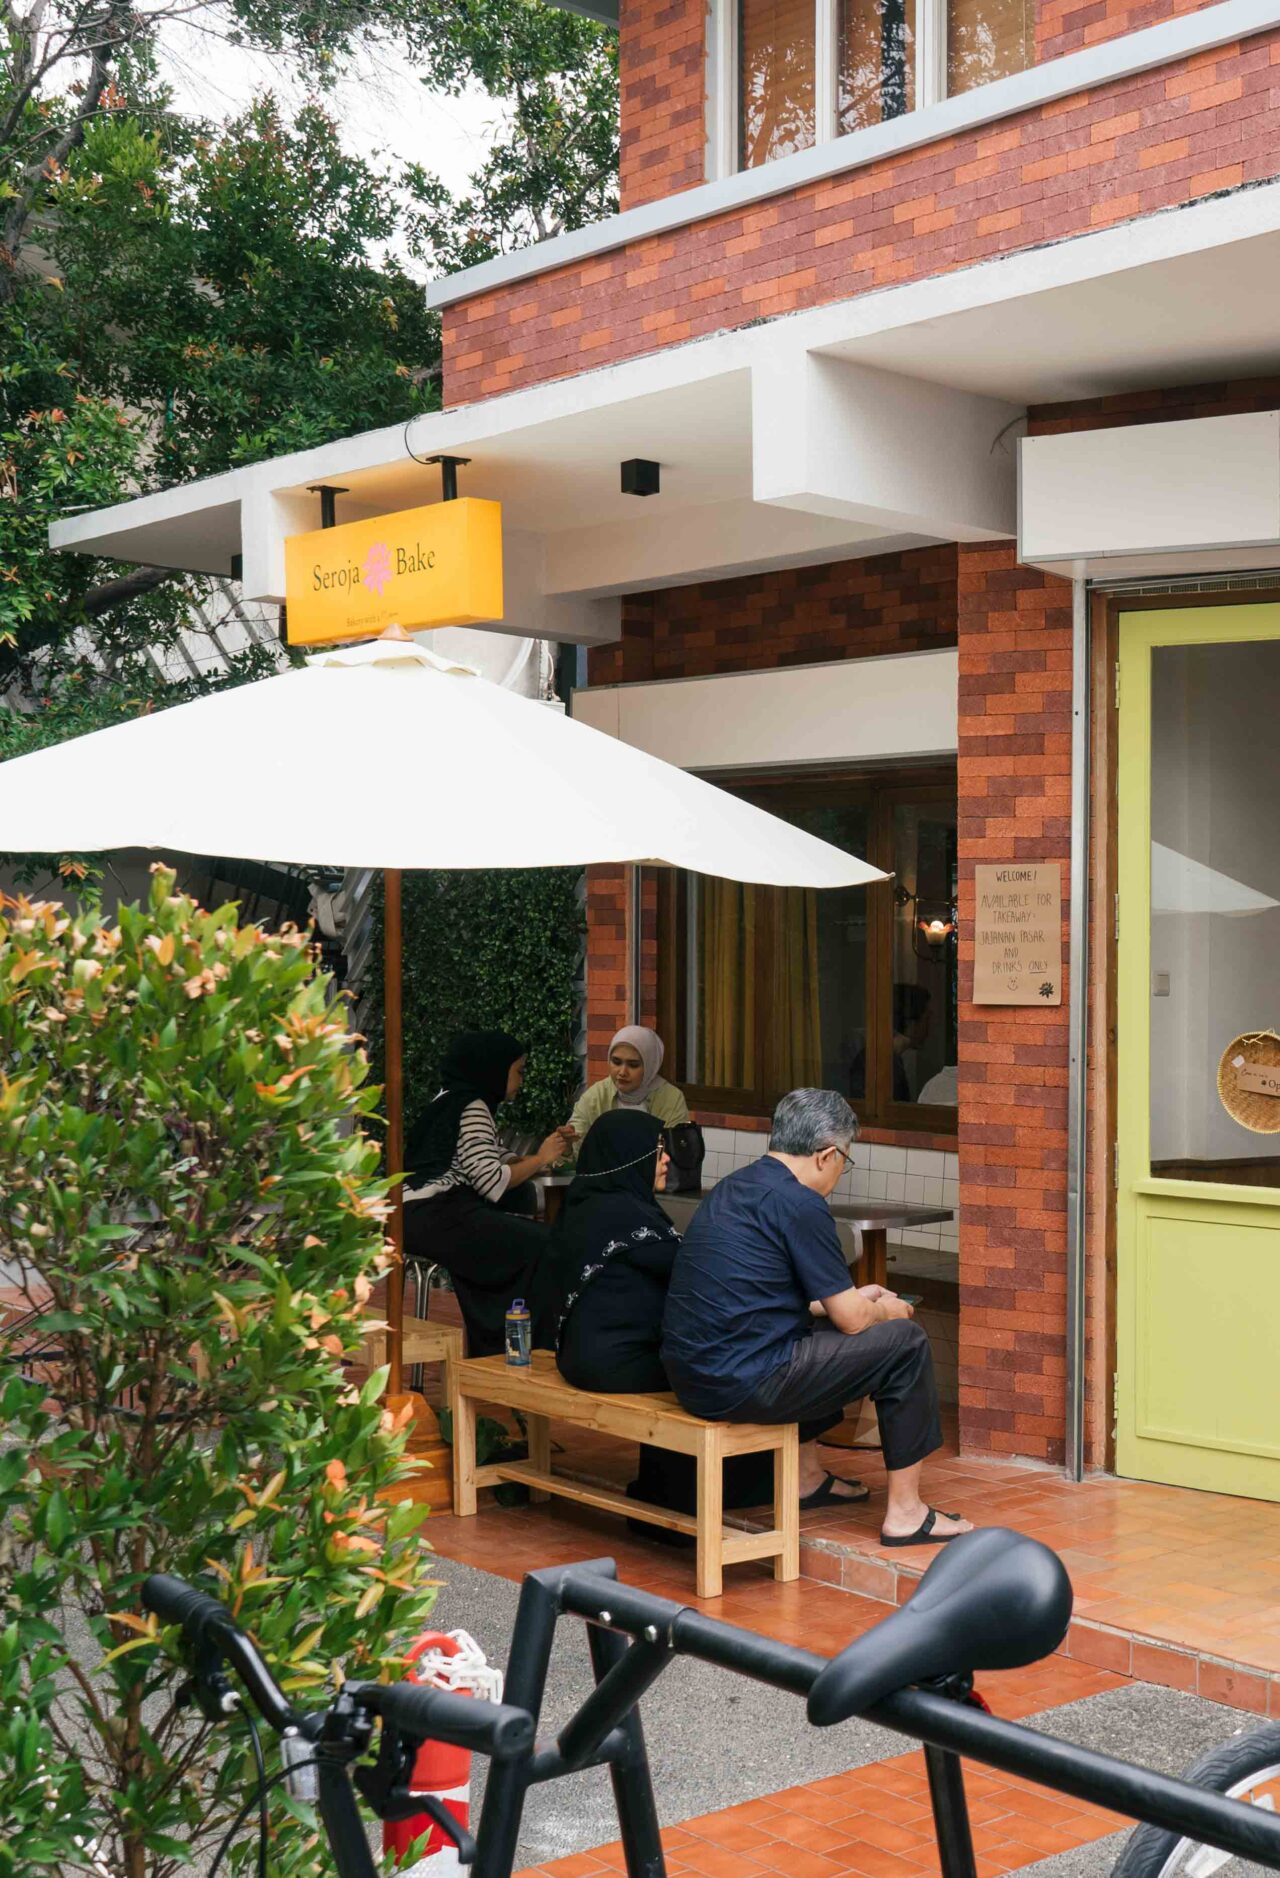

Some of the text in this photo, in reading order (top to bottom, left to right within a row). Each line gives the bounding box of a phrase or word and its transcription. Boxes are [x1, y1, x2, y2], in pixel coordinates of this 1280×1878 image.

[313, 543, 436, 596] Seroja Bake
[996, 870, 1037, 883] WELCOME!
[981, 893, 1052, 908] AVAILABLE FOR
[980, 930, 1046, 945] JAJANAN PASAR
[1003, 947, 1019, 958] AND
[992, 960, 1048, 974] DRINKS ONLY
